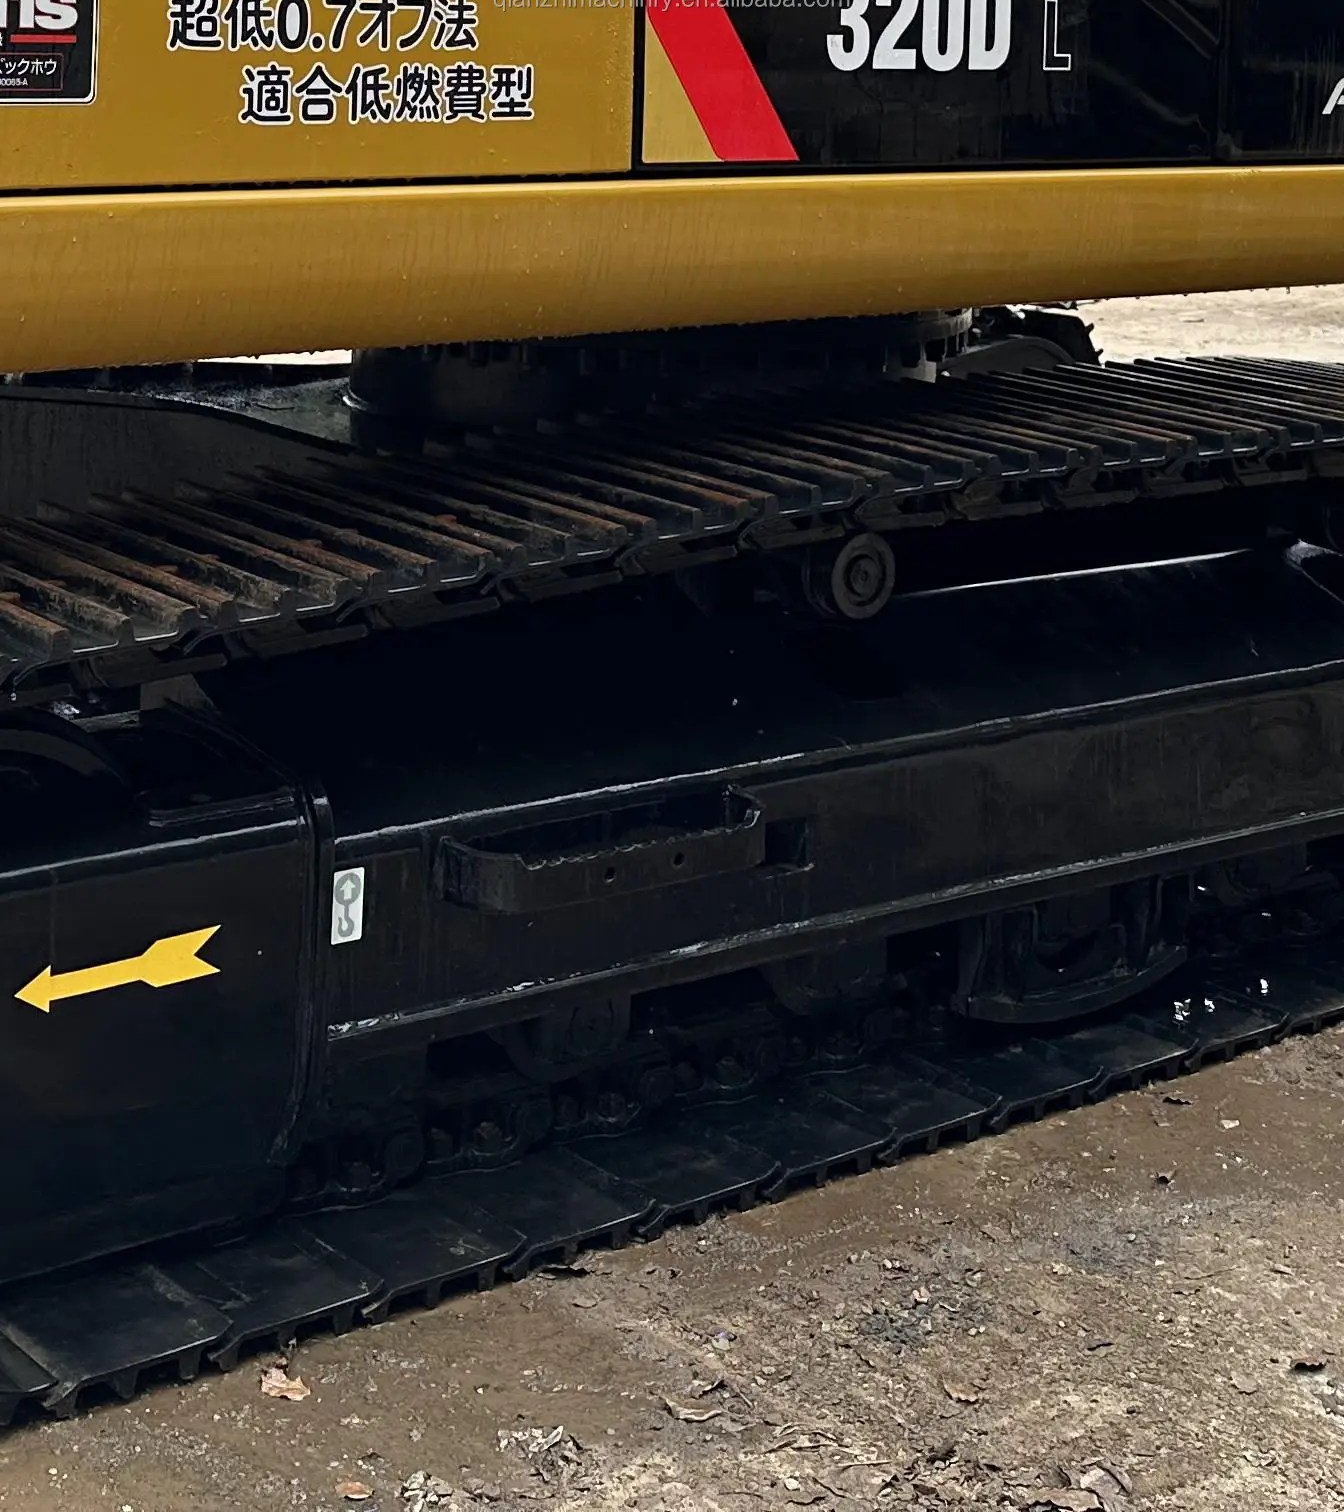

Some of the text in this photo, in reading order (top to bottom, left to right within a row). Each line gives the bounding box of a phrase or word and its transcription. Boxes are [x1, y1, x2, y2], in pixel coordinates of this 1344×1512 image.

[239, 63, 534, 124] 適合低燃費型
